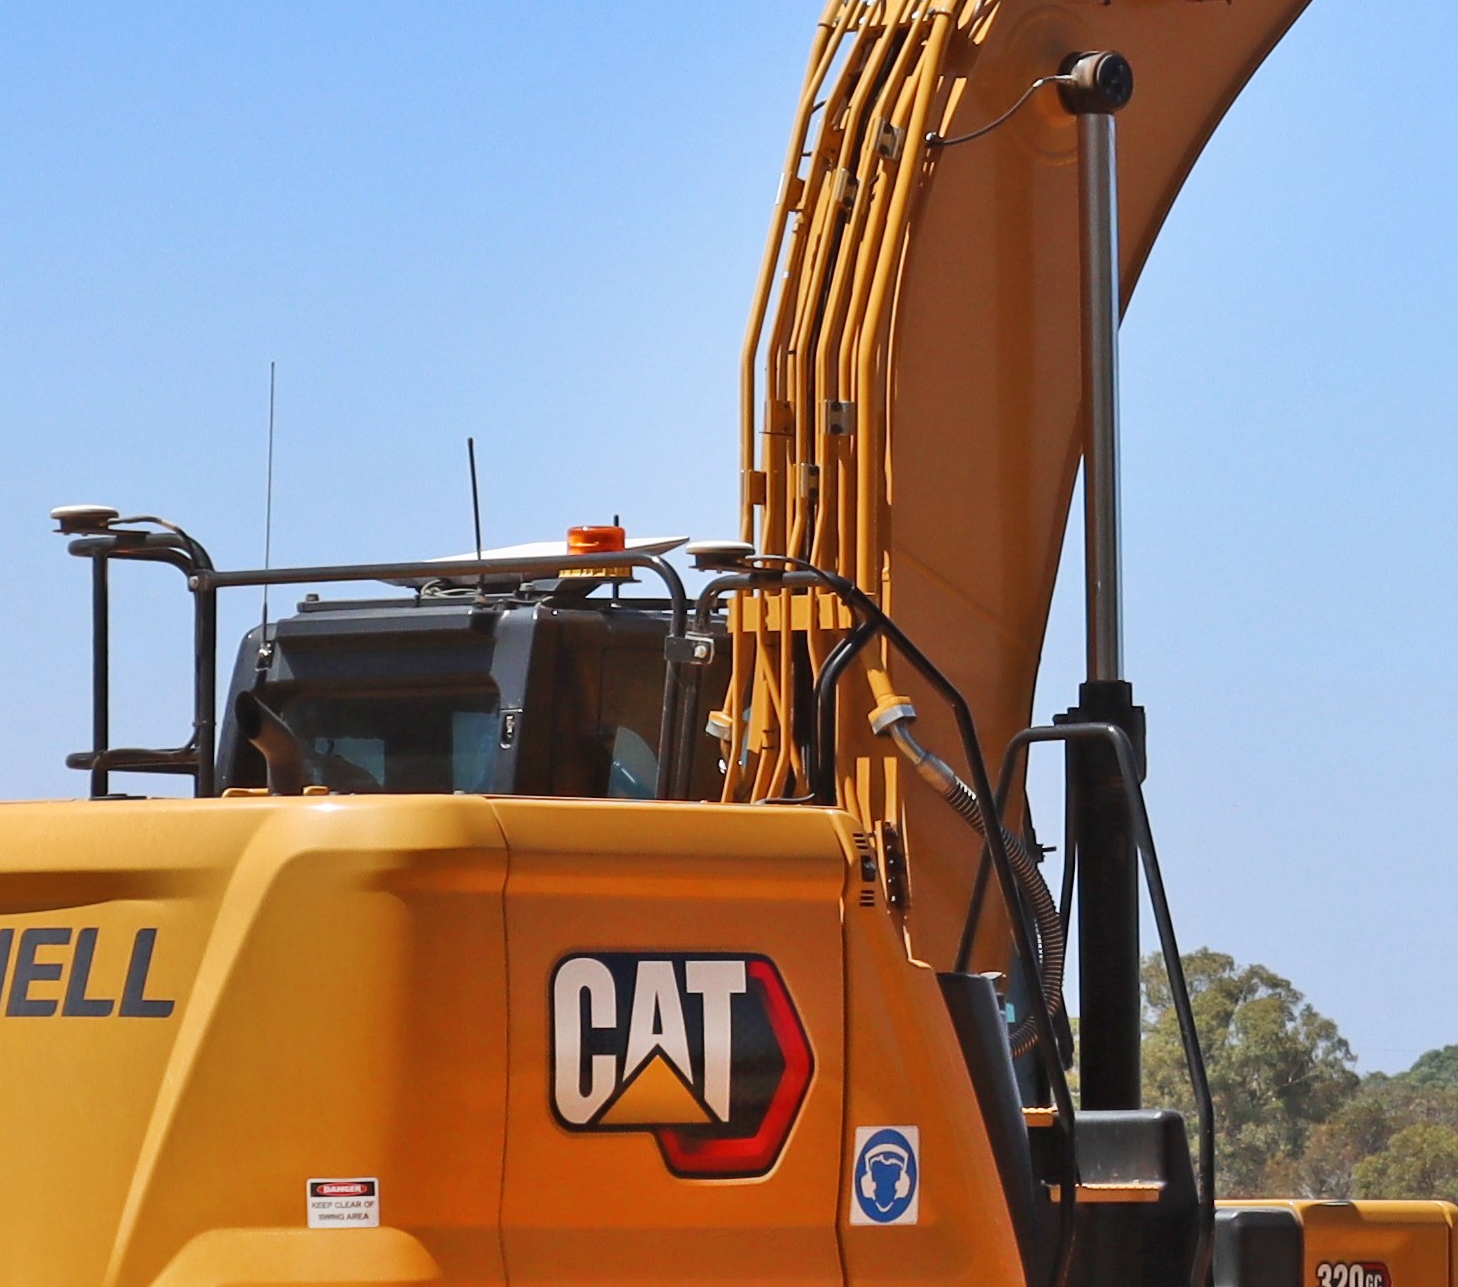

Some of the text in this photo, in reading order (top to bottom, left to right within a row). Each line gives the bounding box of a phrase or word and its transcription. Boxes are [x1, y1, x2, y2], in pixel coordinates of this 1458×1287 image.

[553, 957, 746, 1124] CAT
[323, 1185, 362, 1193] DANGER
[312, 1201, 333, 1209] KEEP
[363, 1200, 375, 1208] OF
